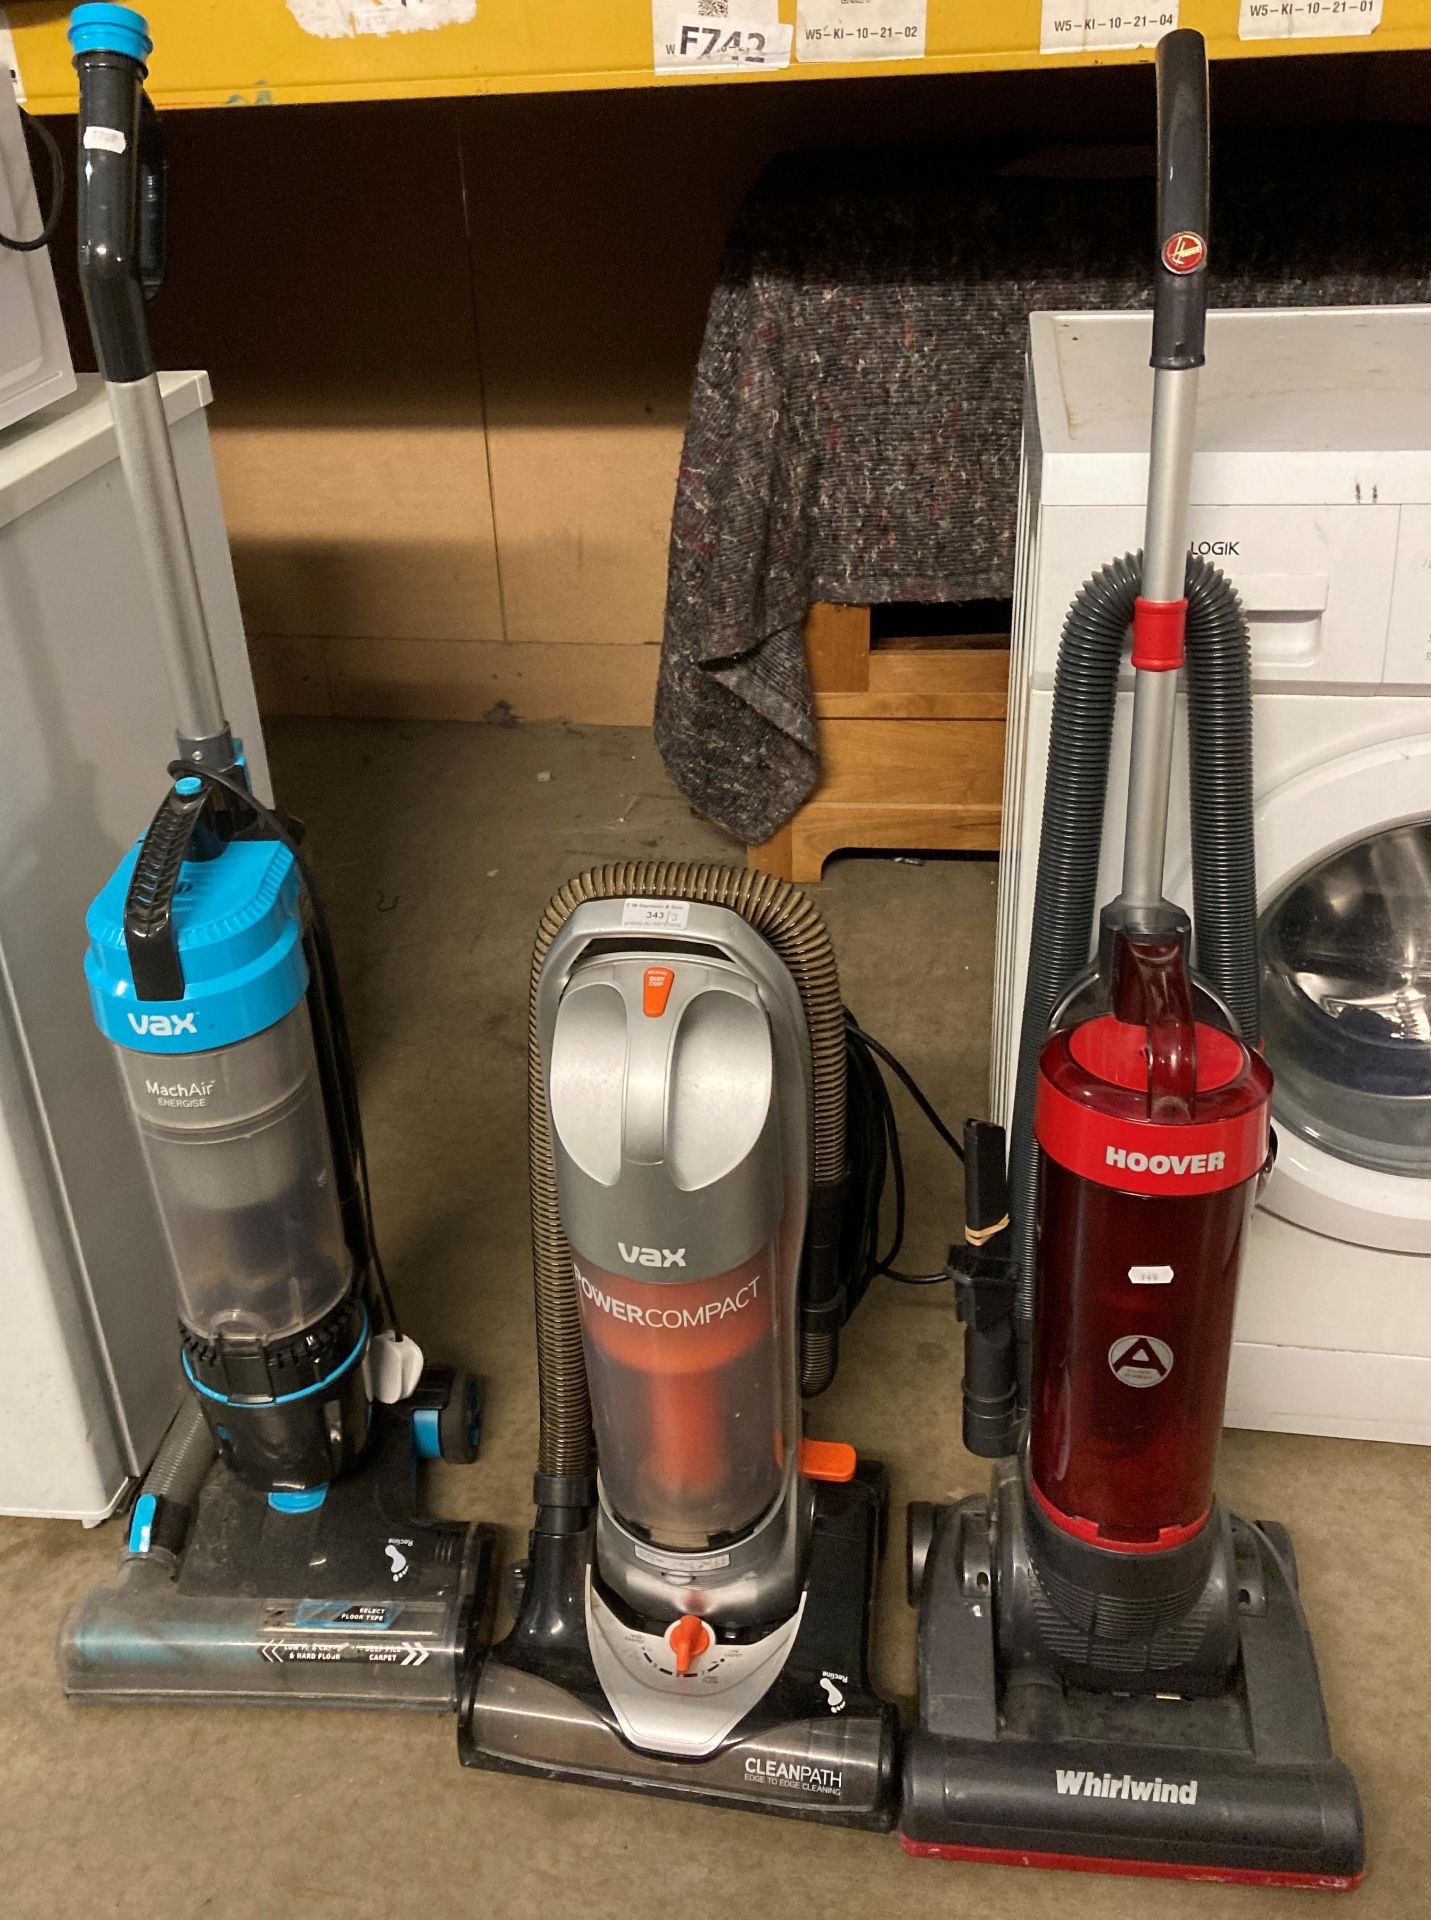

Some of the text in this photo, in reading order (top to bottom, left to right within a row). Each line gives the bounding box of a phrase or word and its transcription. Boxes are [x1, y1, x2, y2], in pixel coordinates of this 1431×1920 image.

[1190, 541, 1240, 555] LOGIK
[646, 911, 665, 919] 343
[145, 1080, 215, 1097] MachAir
[157, 1098, 208, 1108] ENERGISE
[1105, 1145, 1226, 1175] HOOVER
[296, 1652, 316, 1660] HARD
[369, 1653, 398, 1662] CARPET
[744, 1757, 842, 1788] CLEANPATH
[744, 1773, 842, 1796] EDGE TO EDGE CLEANING
[1056, 1769, 1199, 1805] Whirlwind
